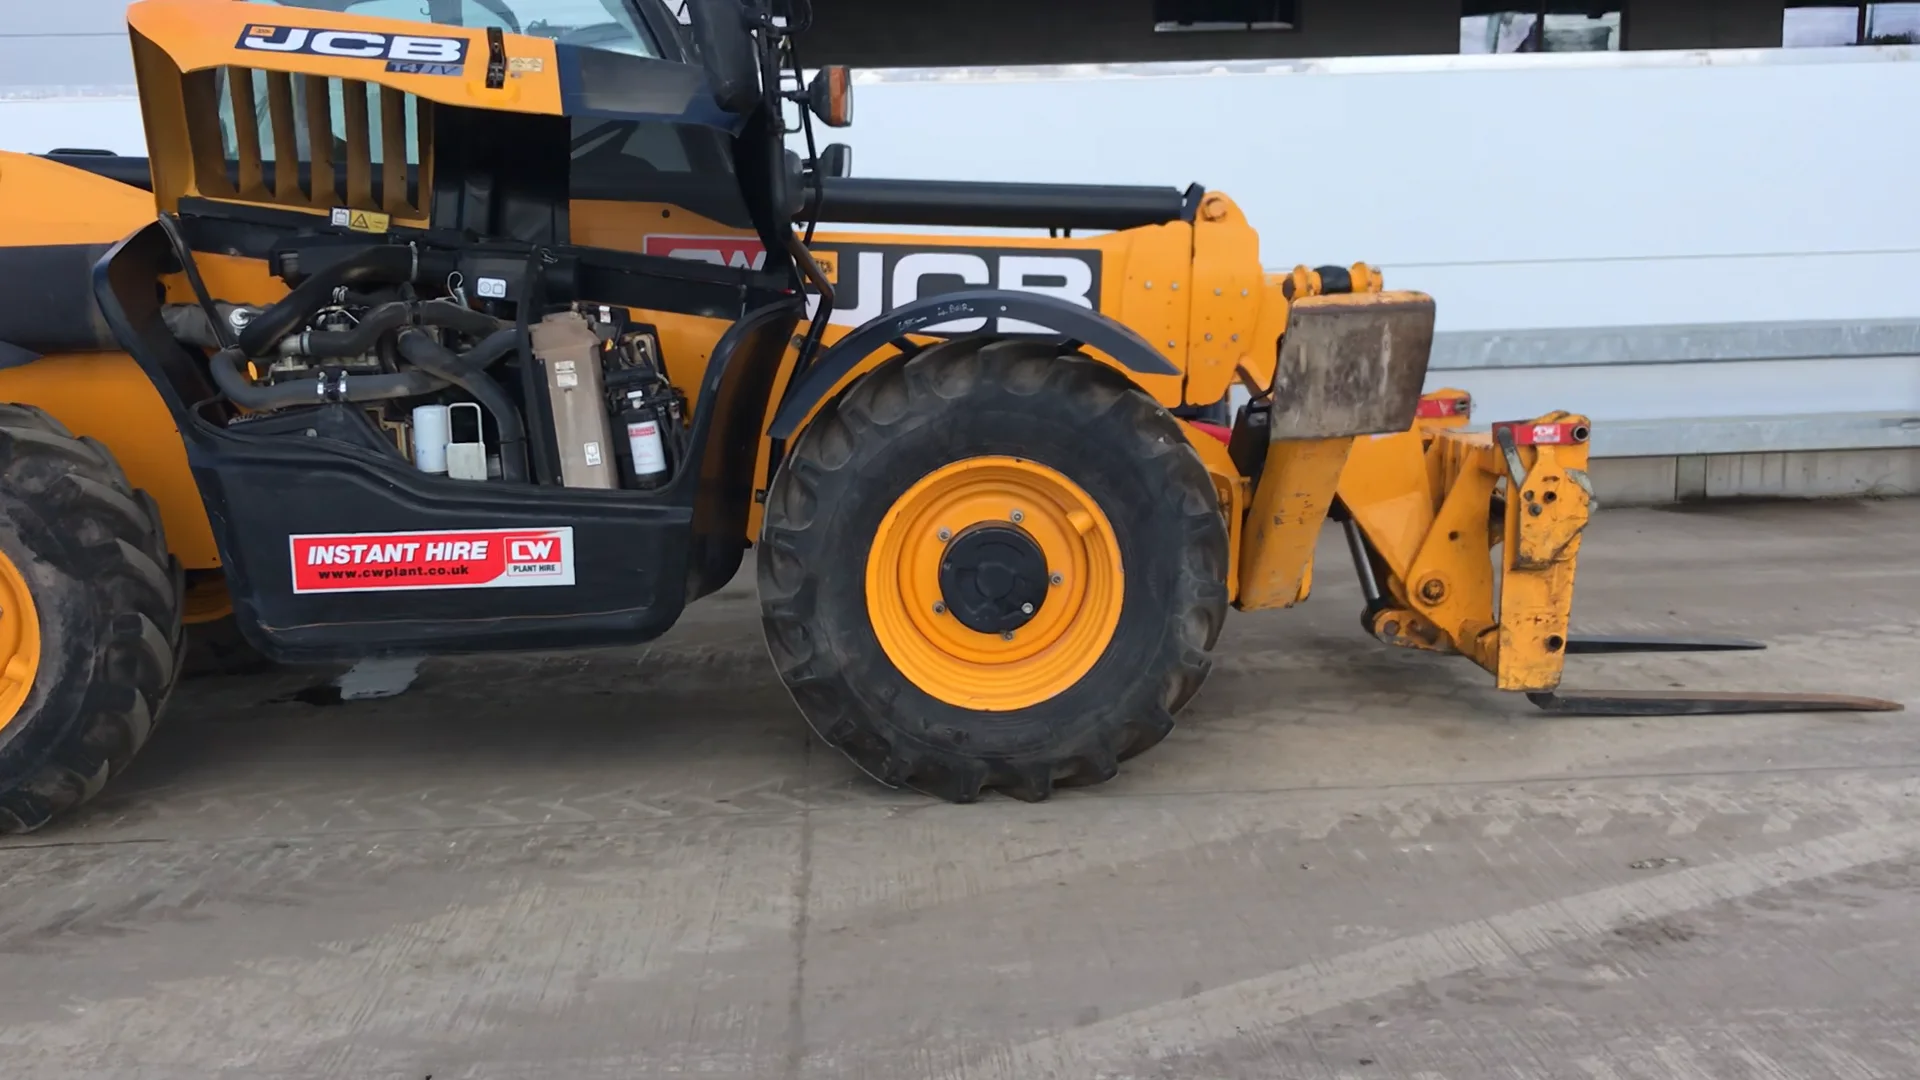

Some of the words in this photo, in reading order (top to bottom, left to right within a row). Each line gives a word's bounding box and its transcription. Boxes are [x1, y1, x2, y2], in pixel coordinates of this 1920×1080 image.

[243, 28, 462, 62] JCB
[805, 251, 1093, 333] JCB
[307, 542, 426, 565] INSTANT
[425, 540, 489, 562] HIRE
[511, 540, 554, 560] CW
[318, 565, 469, 580] www.cwplant.co.uk
[512, 565, 538, 573] PLANT
[538, 564, 556, 572] HIRE
